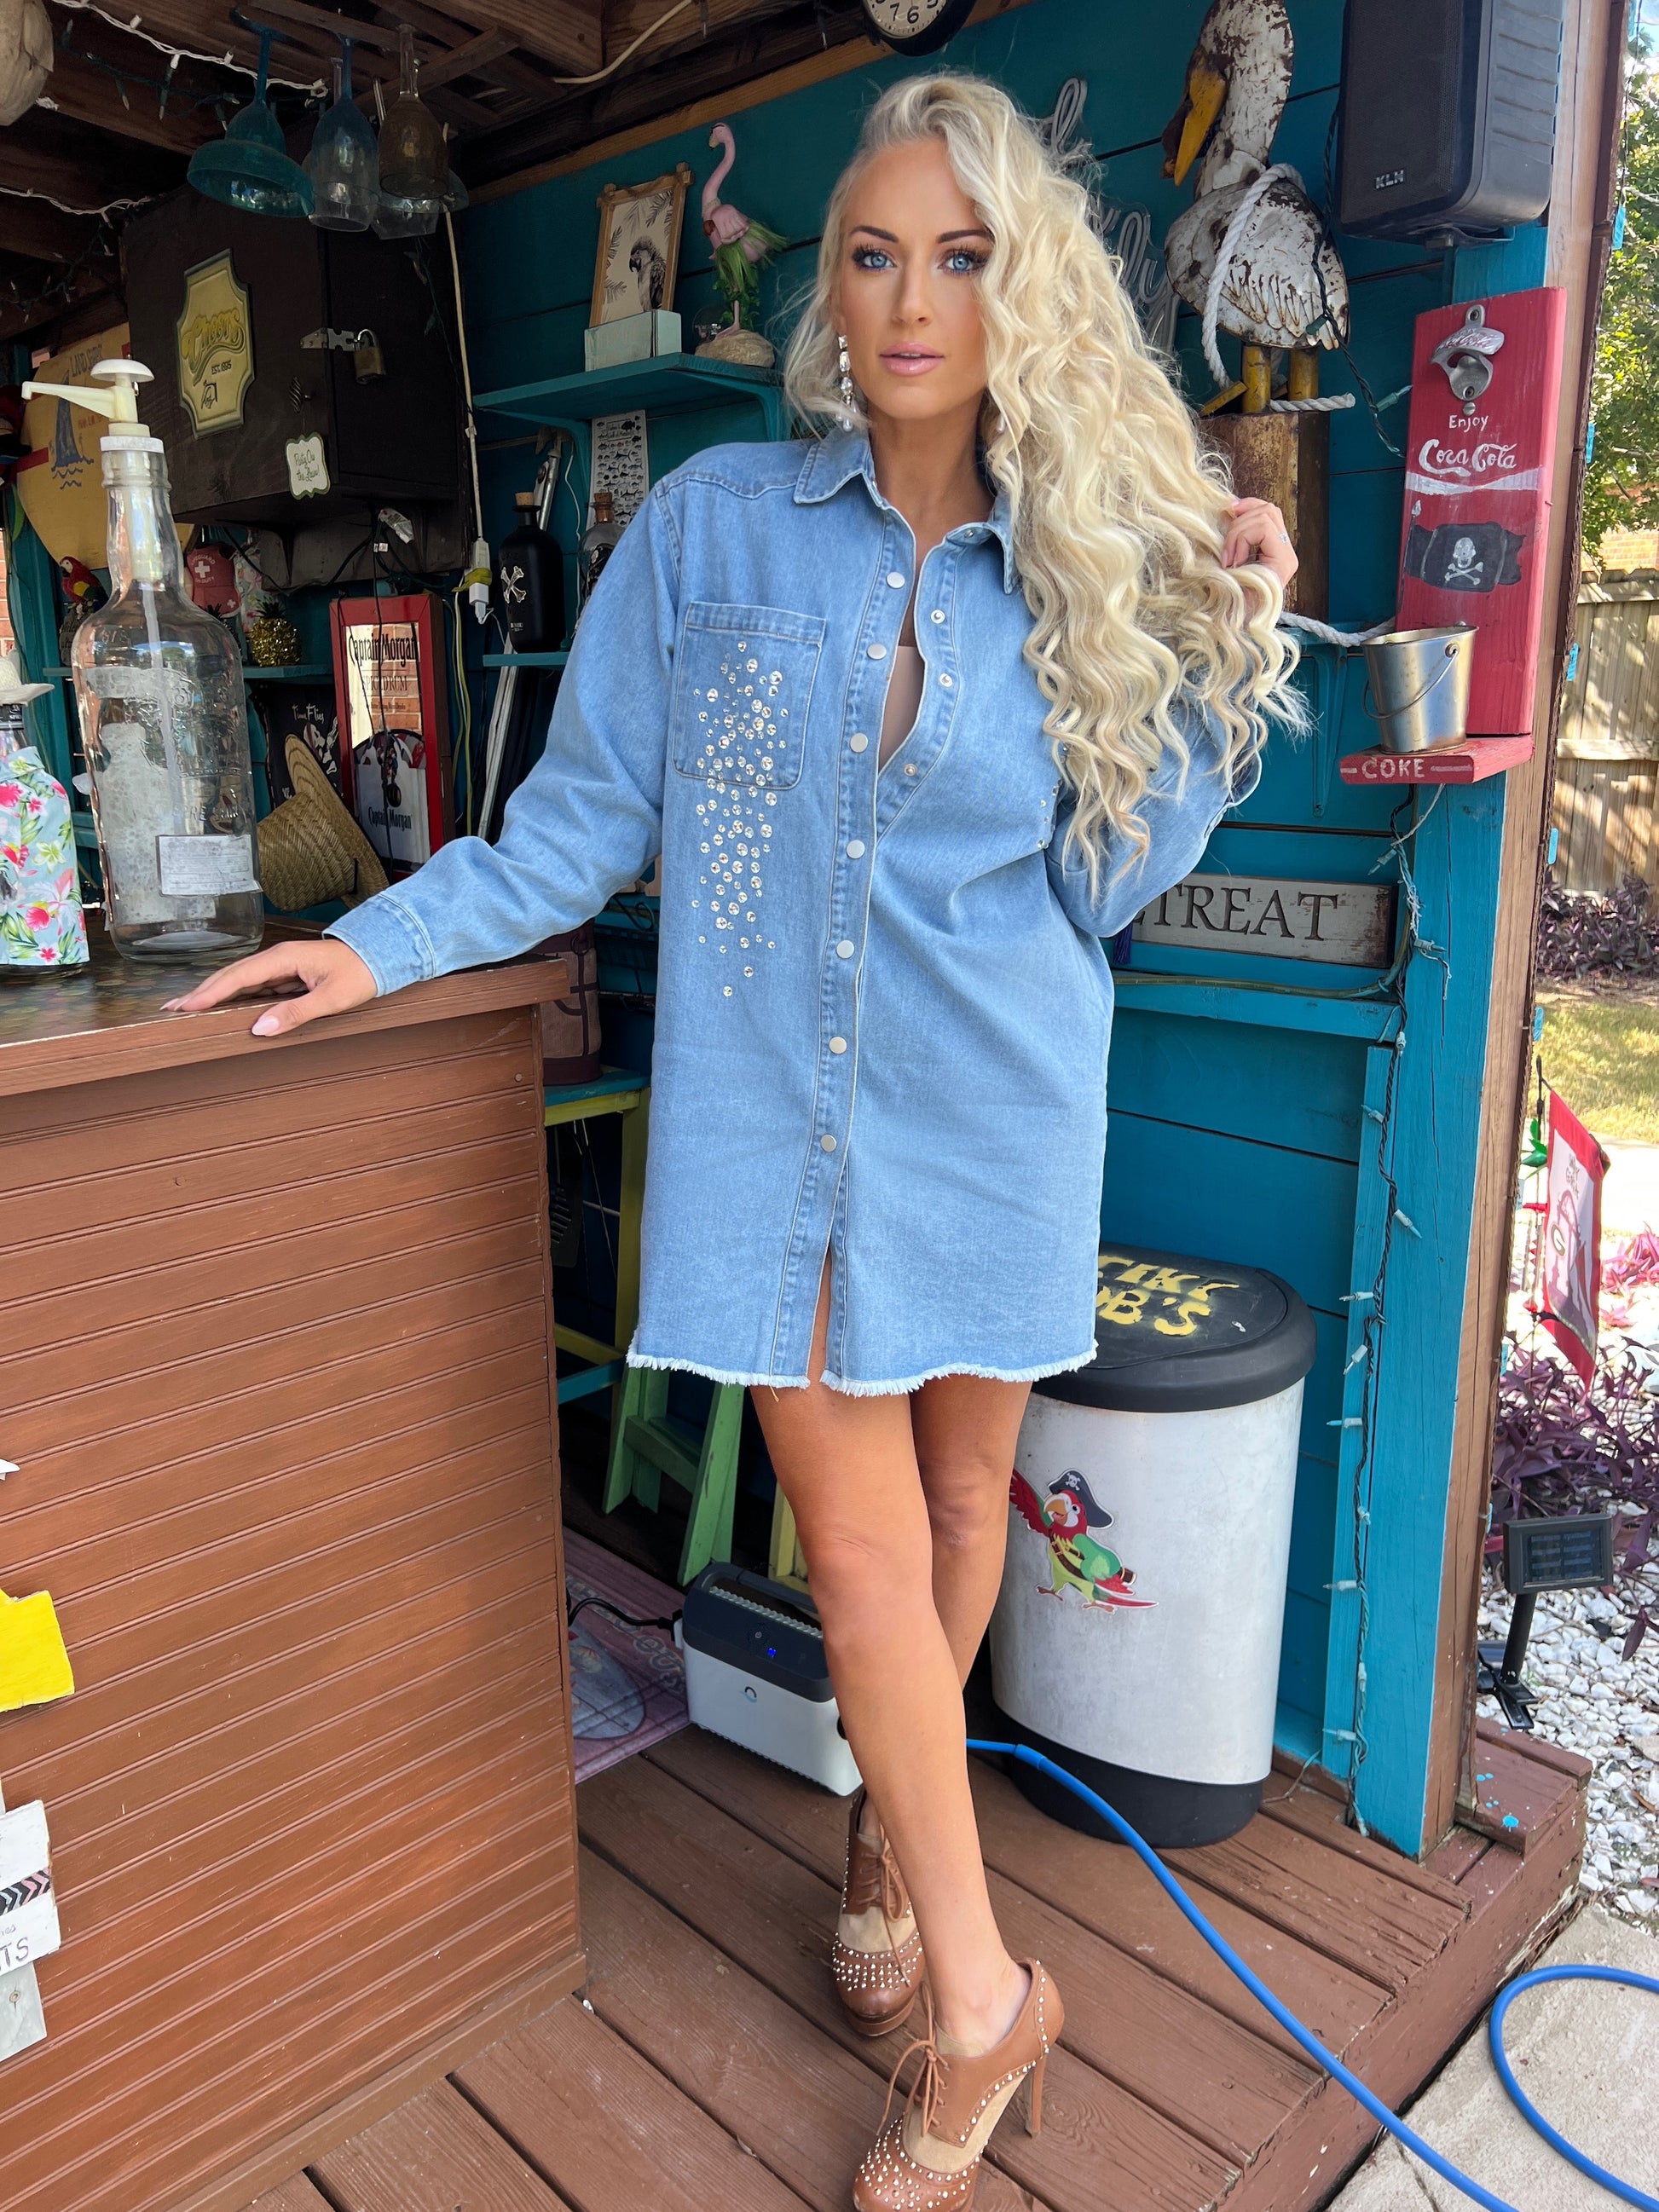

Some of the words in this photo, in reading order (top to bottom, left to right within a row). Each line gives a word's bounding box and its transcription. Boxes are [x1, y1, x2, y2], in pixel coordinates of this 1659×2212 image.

[890, 3, 900, 21] 7
[907, 6, 920, 24] 6
[1376, 170, 1405, 189] KLH
[1448, 414, 1488, 433] Enjoy
[1361, 757, 1425, 779] COKE
[1134, 883, 1338, 941] TREAT
[0, 1936, 29, 1972] TS
